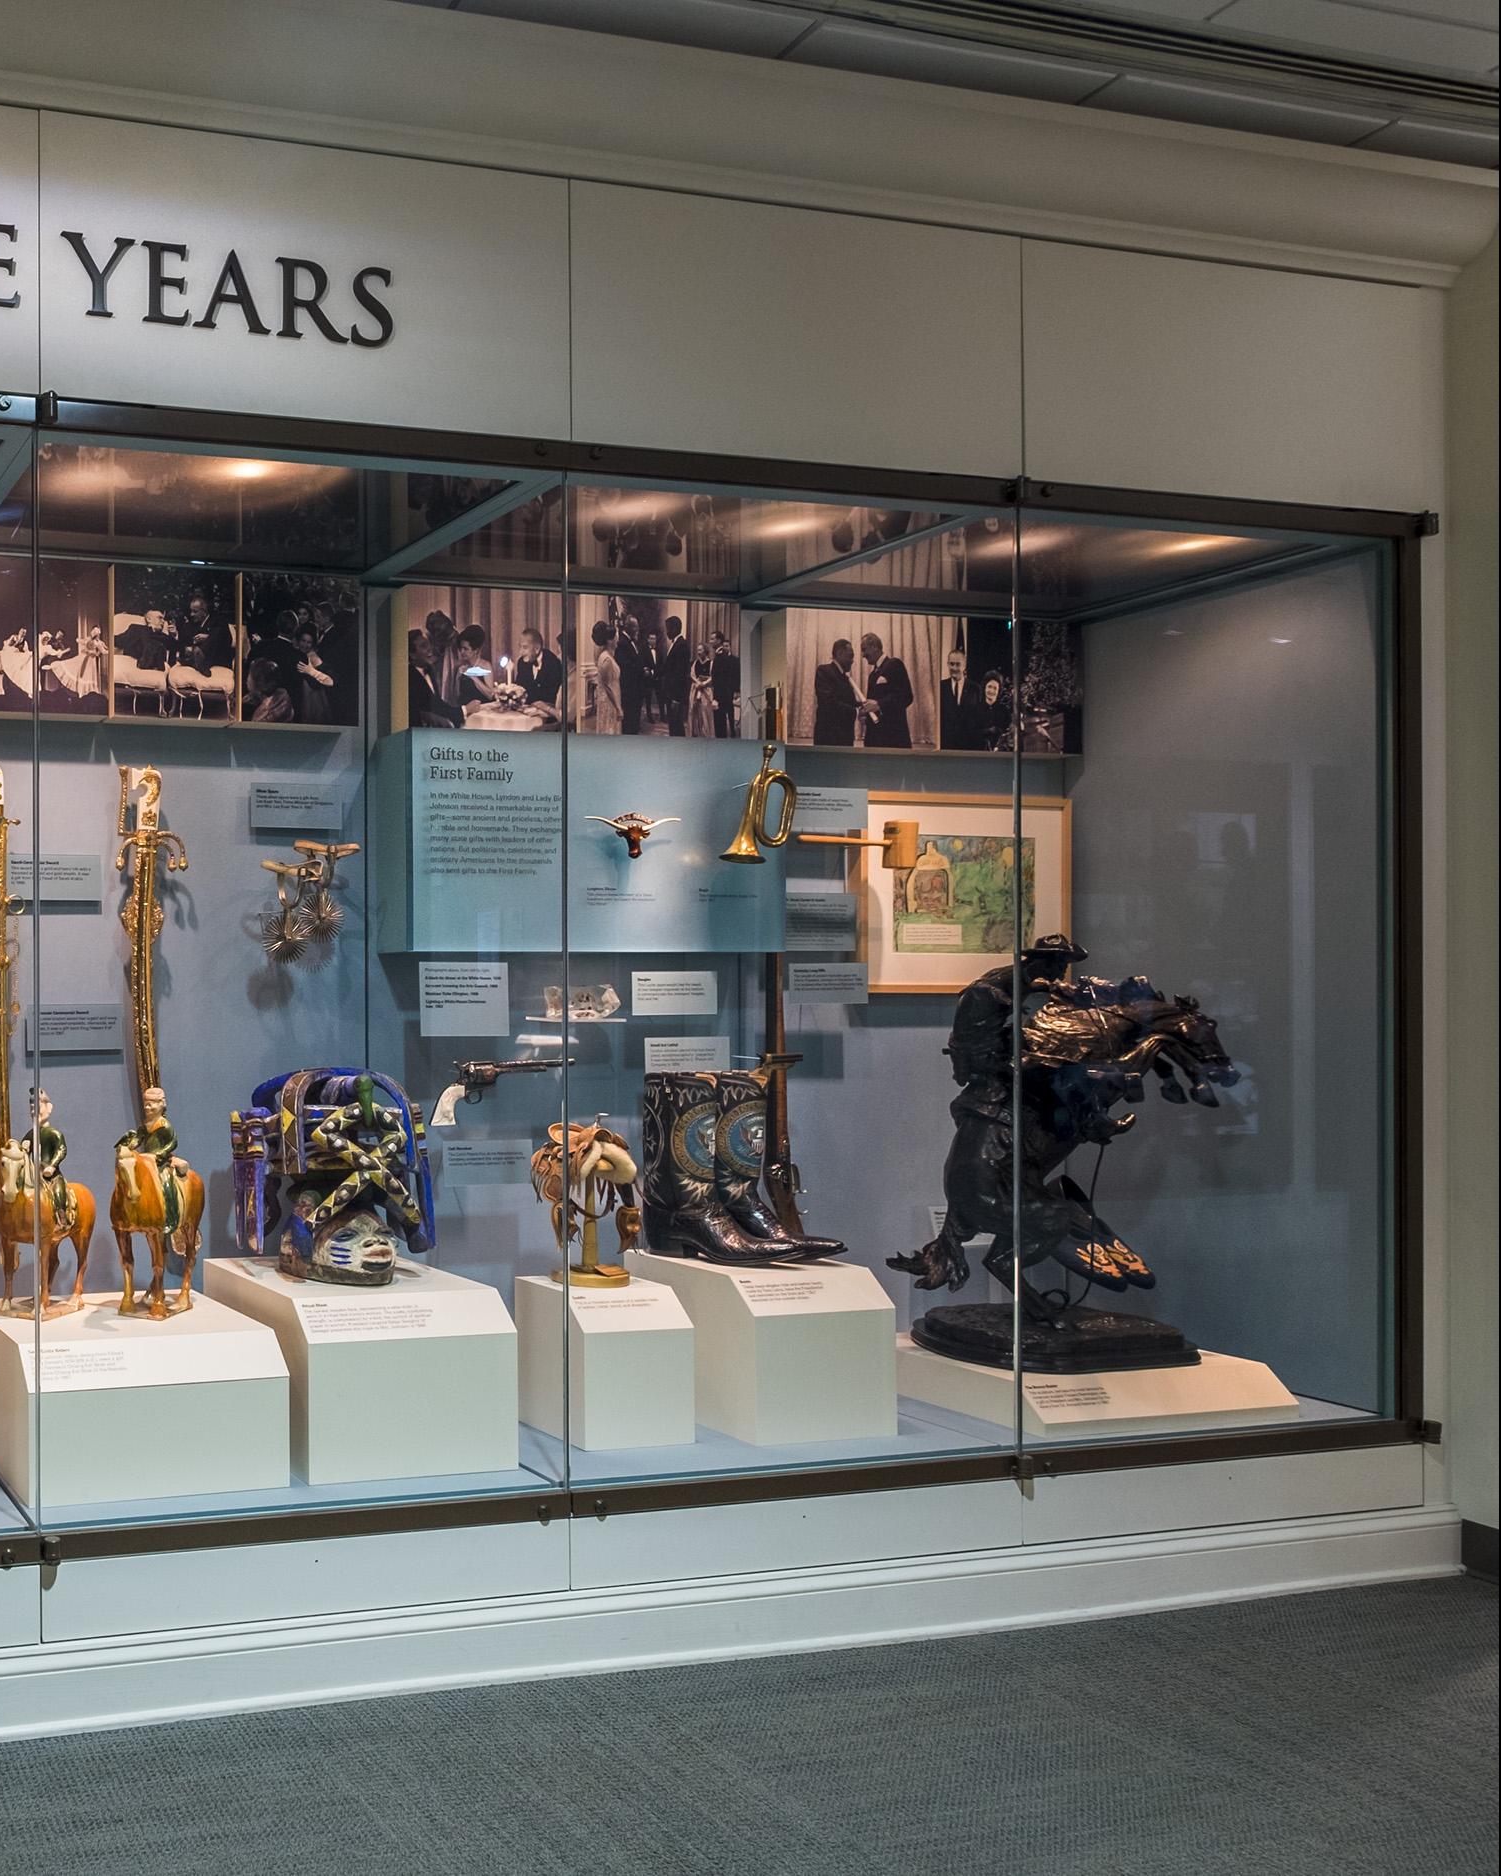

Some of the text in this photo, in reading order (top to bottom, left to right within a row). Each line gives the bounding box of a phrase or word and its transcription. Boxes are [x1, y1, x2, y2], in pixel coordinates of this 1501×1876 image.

[60, 230, 394, 348] YEARS
[430, 746, 509, 763] Gifts to the
[430, 766, 514, 784] First Family
